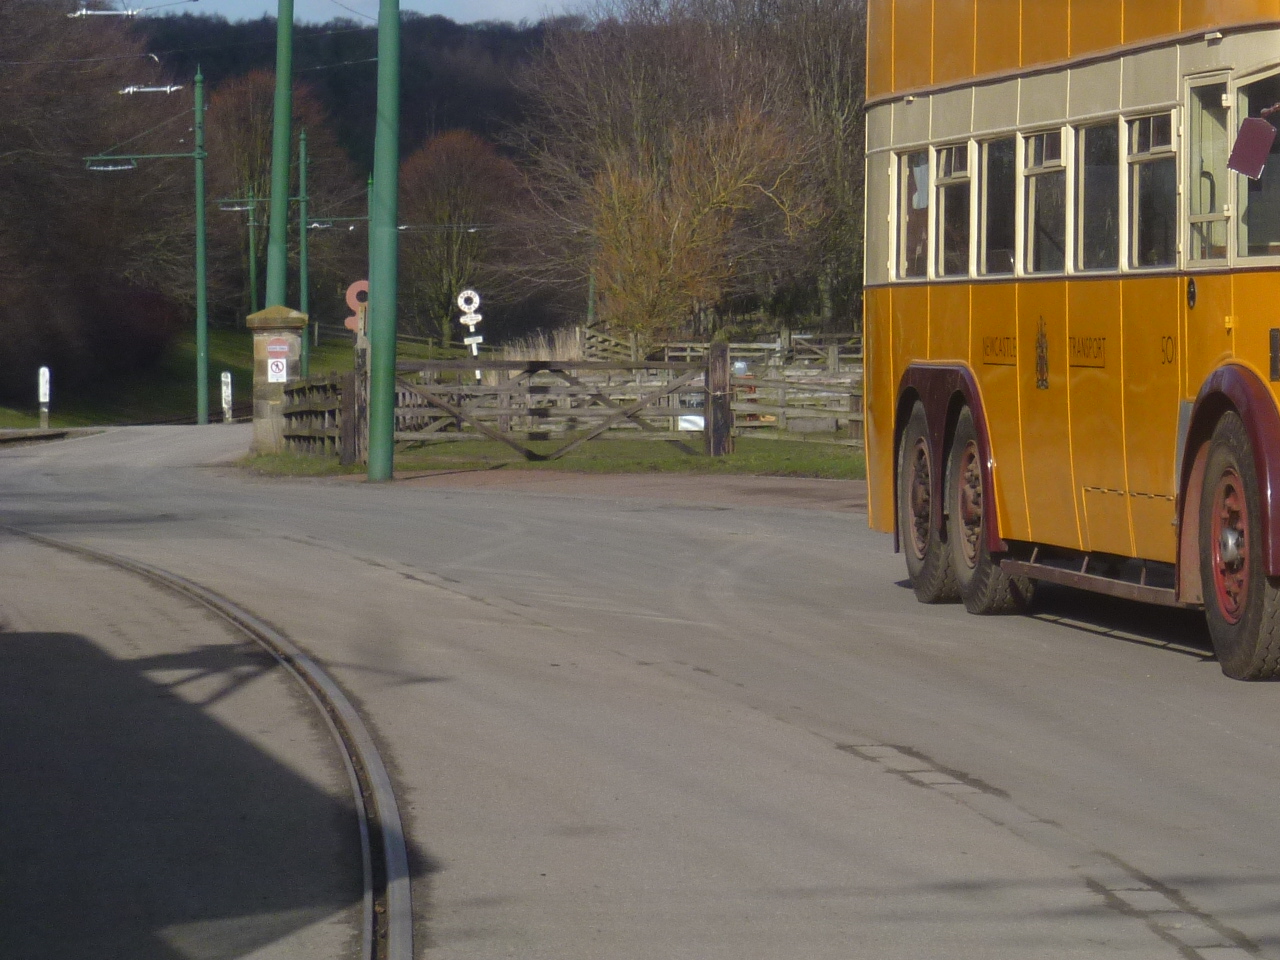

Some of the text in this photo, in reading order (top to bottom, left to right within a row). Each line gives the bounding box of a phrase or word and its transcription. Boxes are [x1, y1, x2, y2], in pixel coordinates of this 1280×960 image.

[983, 337, 1106, 360] NEWCASTLE TRANSPORT
[1162, 336, 1177, 365] 501
